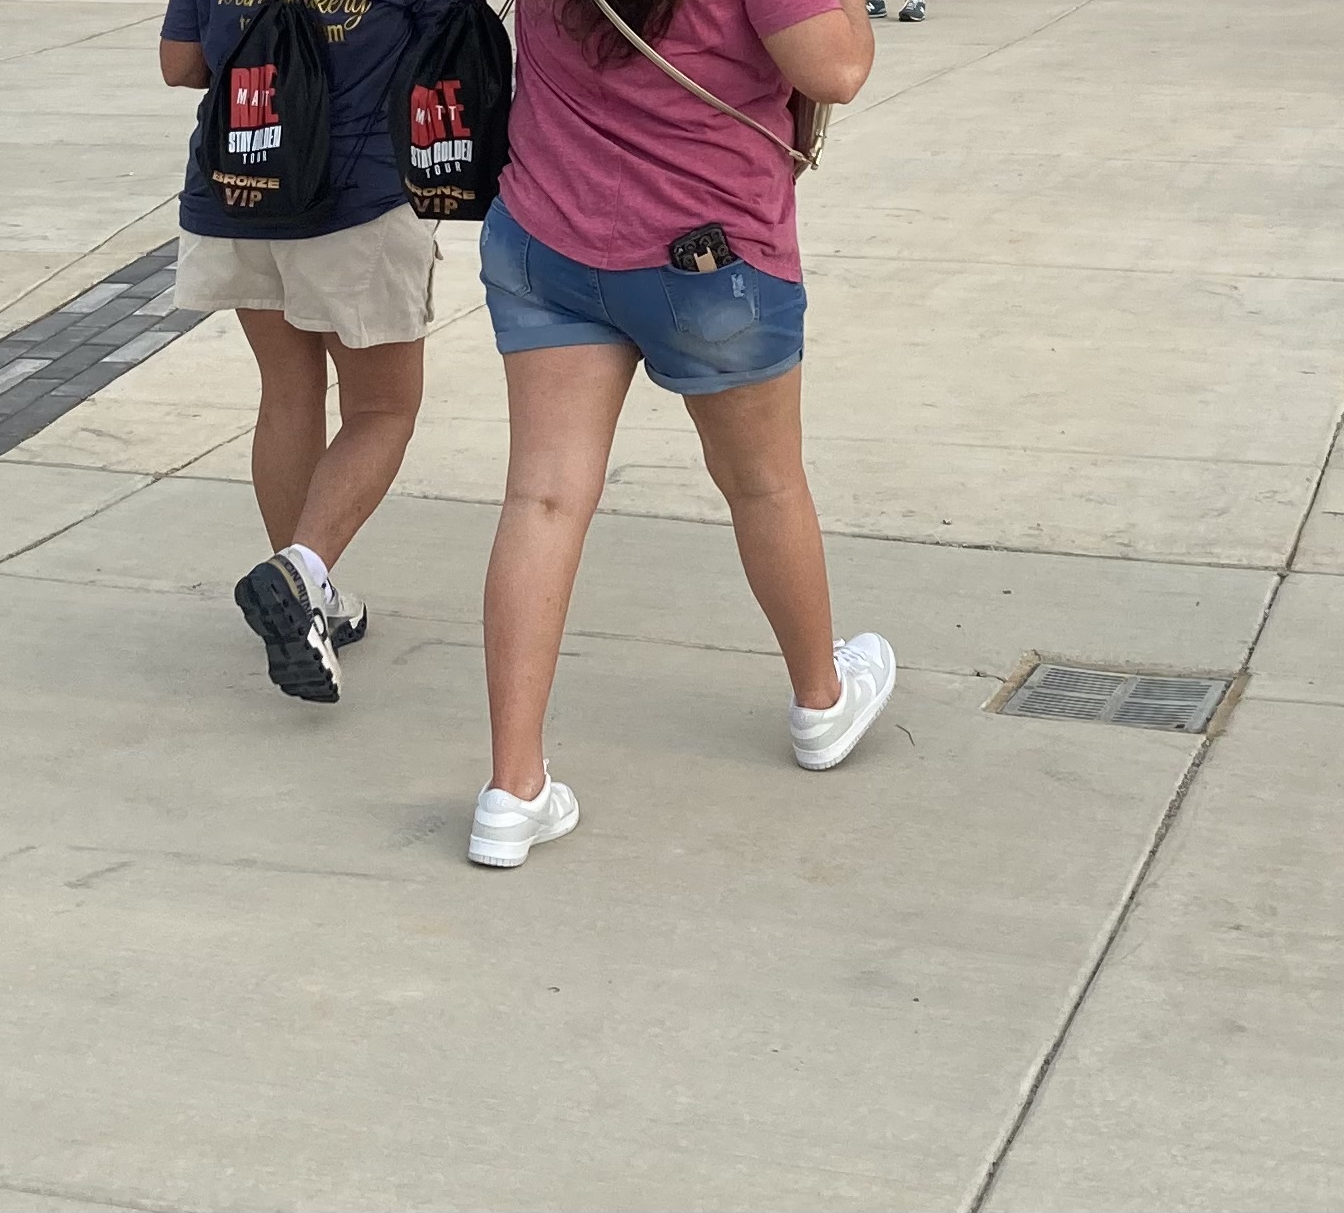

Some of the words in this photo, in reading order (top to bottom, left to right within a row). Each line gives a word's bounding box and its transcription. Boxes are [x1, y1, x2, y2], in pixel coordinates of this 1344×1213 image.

[242, 150, 267, 165] TOUR
[434, 140, 473, 163] GOLDEN
[426, 161, 462, 178] TOUR
[212, 170, 280, 189] BRONZE
[225, 188, 263, 208] VIP
[414, 196, 458, 215] VIP
